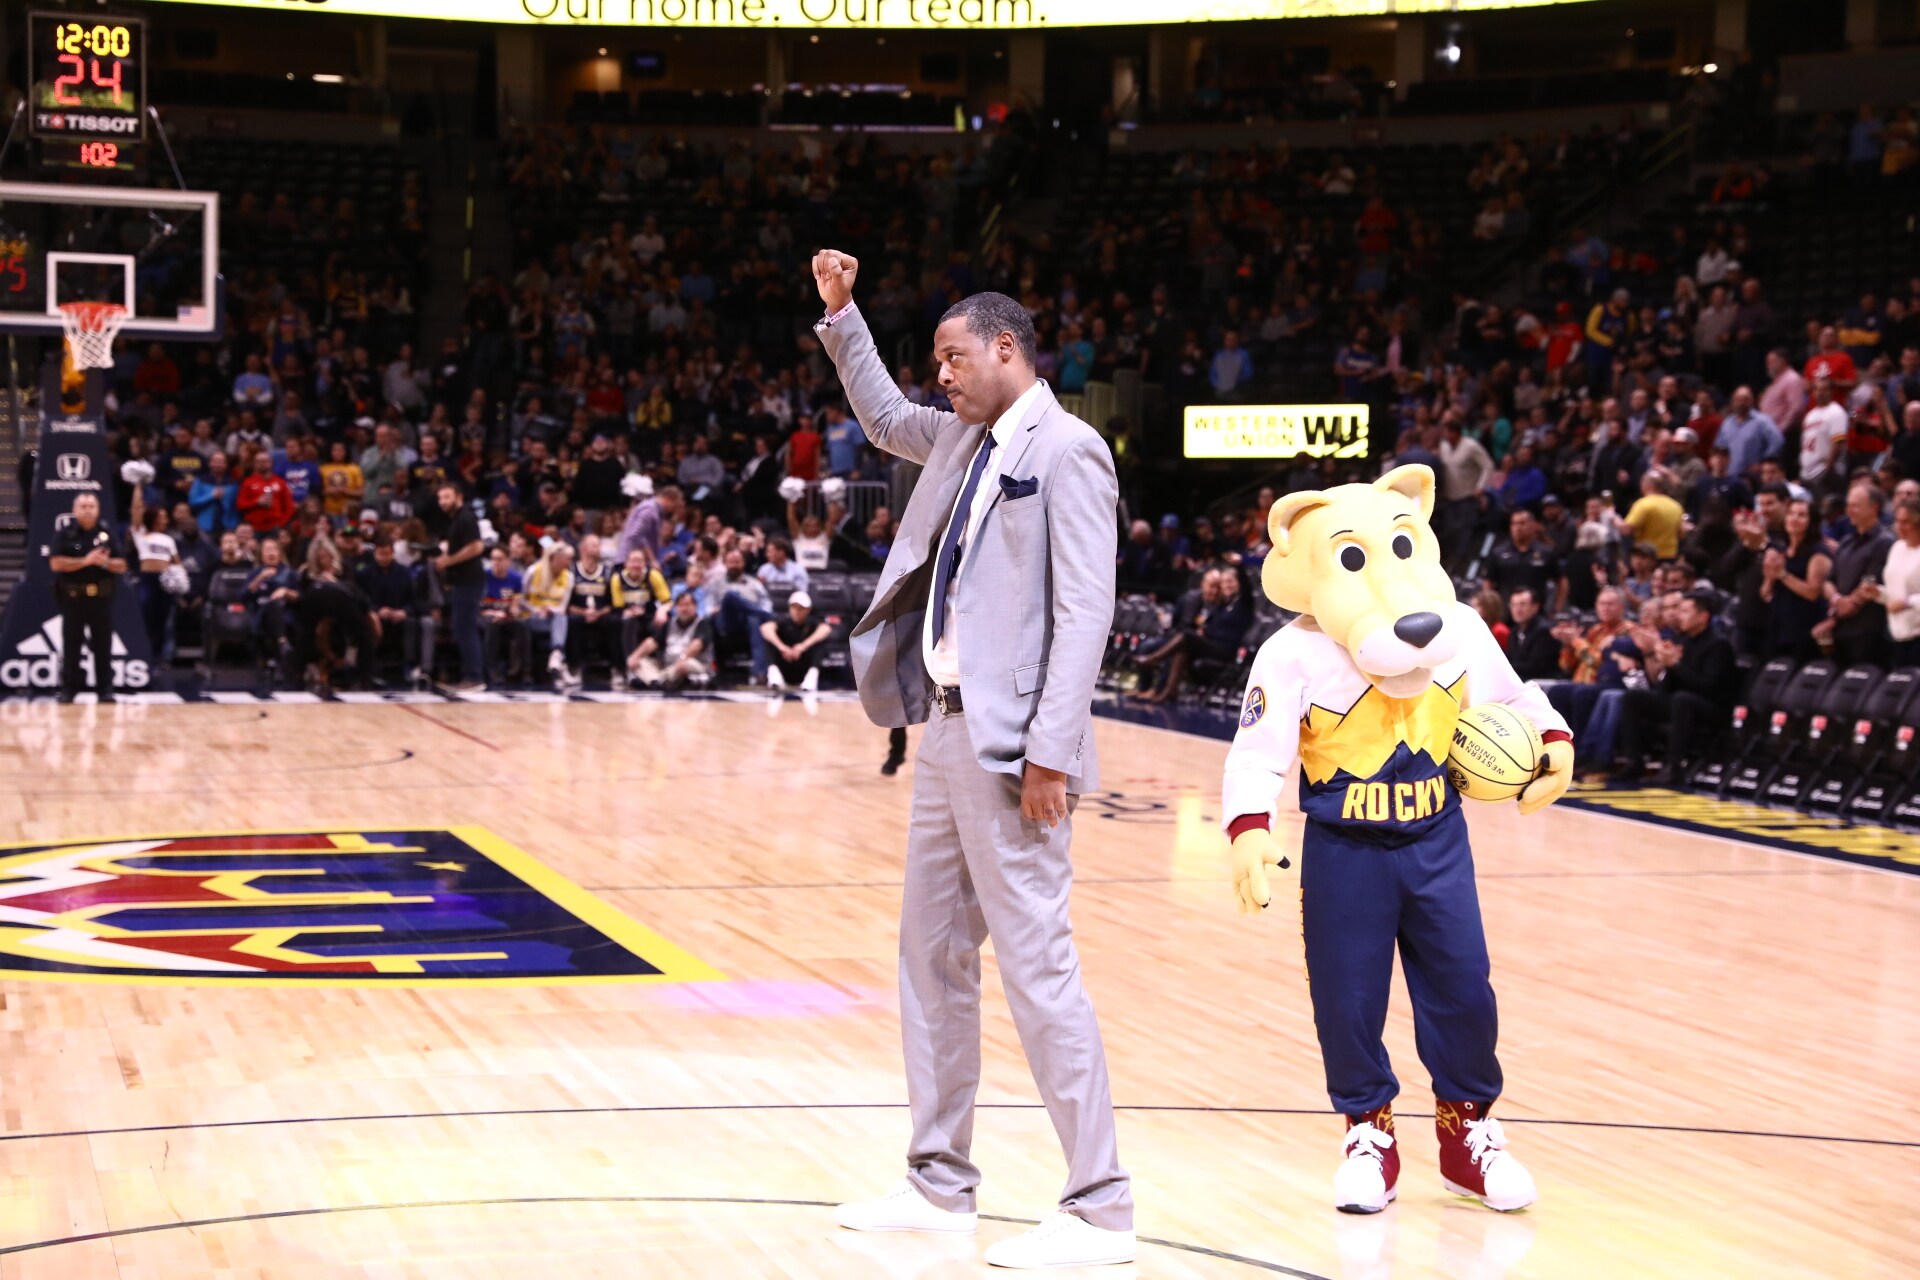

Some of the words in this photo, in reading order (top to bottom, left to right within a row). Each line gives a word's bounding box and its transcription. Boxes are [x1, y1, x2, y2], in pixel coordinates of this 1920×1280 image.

[800, 0, 884, 22] Our
[909, 0, 1046, 23] team.
[56, 23, 130, 57] 12:00
[53, 53, 122, 106] 24
[65, 114, 139, 133] TISSOT
[1193, 415, 1295, 430] WESTERN
[1224, 432, 1295, 448] UNION
[1465, 746, 1505, 776] WESTERN
[1468, 740, 1497, 763] UNION
[1341, 774, 1446, 822] ROCKY
